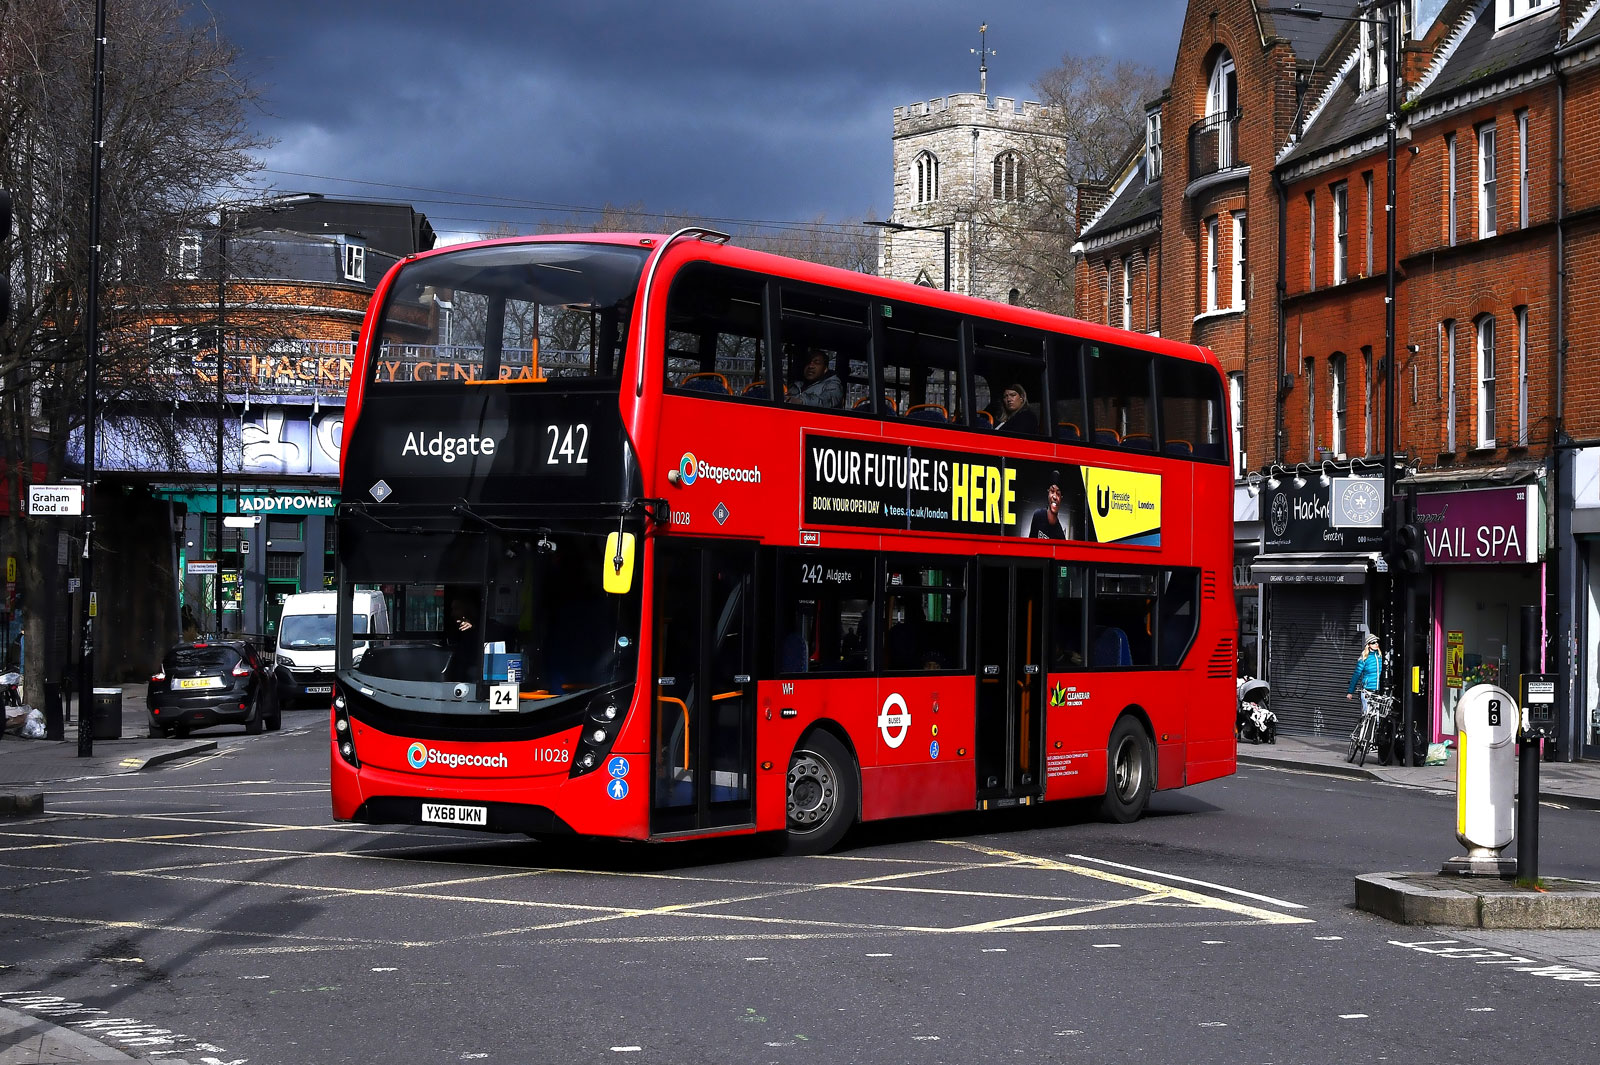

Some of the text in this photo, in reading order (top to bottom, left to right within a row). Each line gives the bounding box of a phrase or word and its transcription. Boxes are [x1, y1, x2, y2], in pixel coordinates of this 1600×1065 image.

[413, 361, 546, 382] CENRAL
[401, 431, 495, 463] Aldgate
[547, 423, 589, 465] 242
[698, 459, 761, 484] Stagecoach
[812, 447, 1017, 525] YOUR FUTURE IS HERE
[1344, 484, 1378, 502] HACKNEY
[32, 493, 70, 502] Graham
[1111, 490, 1130, 502] Teesside
[32, 503, 57, 512] Road
[812, 496, 880, 515] BOOK YOUR OPEN DAY
[889, 503, 949, 520] tees.ac.uk/london
[1110, 500, 1155, 514] University London
[1293, 493, 1330, 520] Hackne
[669, 510, 691, 525] 11028
[1346, 508, 1377, 523] FRESH
[803, 533, 817, 544] global
[1323, 529, 1344, 546] Grocery
[1424, 525, 1522, 558] NAIL SPA
[802, 563, 852, 584] 242 Aldgate
[495, 689, 513, 705] 24
[782, 682, 795, 696] WH
[888, 716, 902, 725] BUSES
[428, 748, 569, 768] Stagecoach 11028
[426, 805, 482, 822] YX68 UKN
[1387, 940, 1538, 964] LEFT
[1504, 964, 1600, 987] OOK
